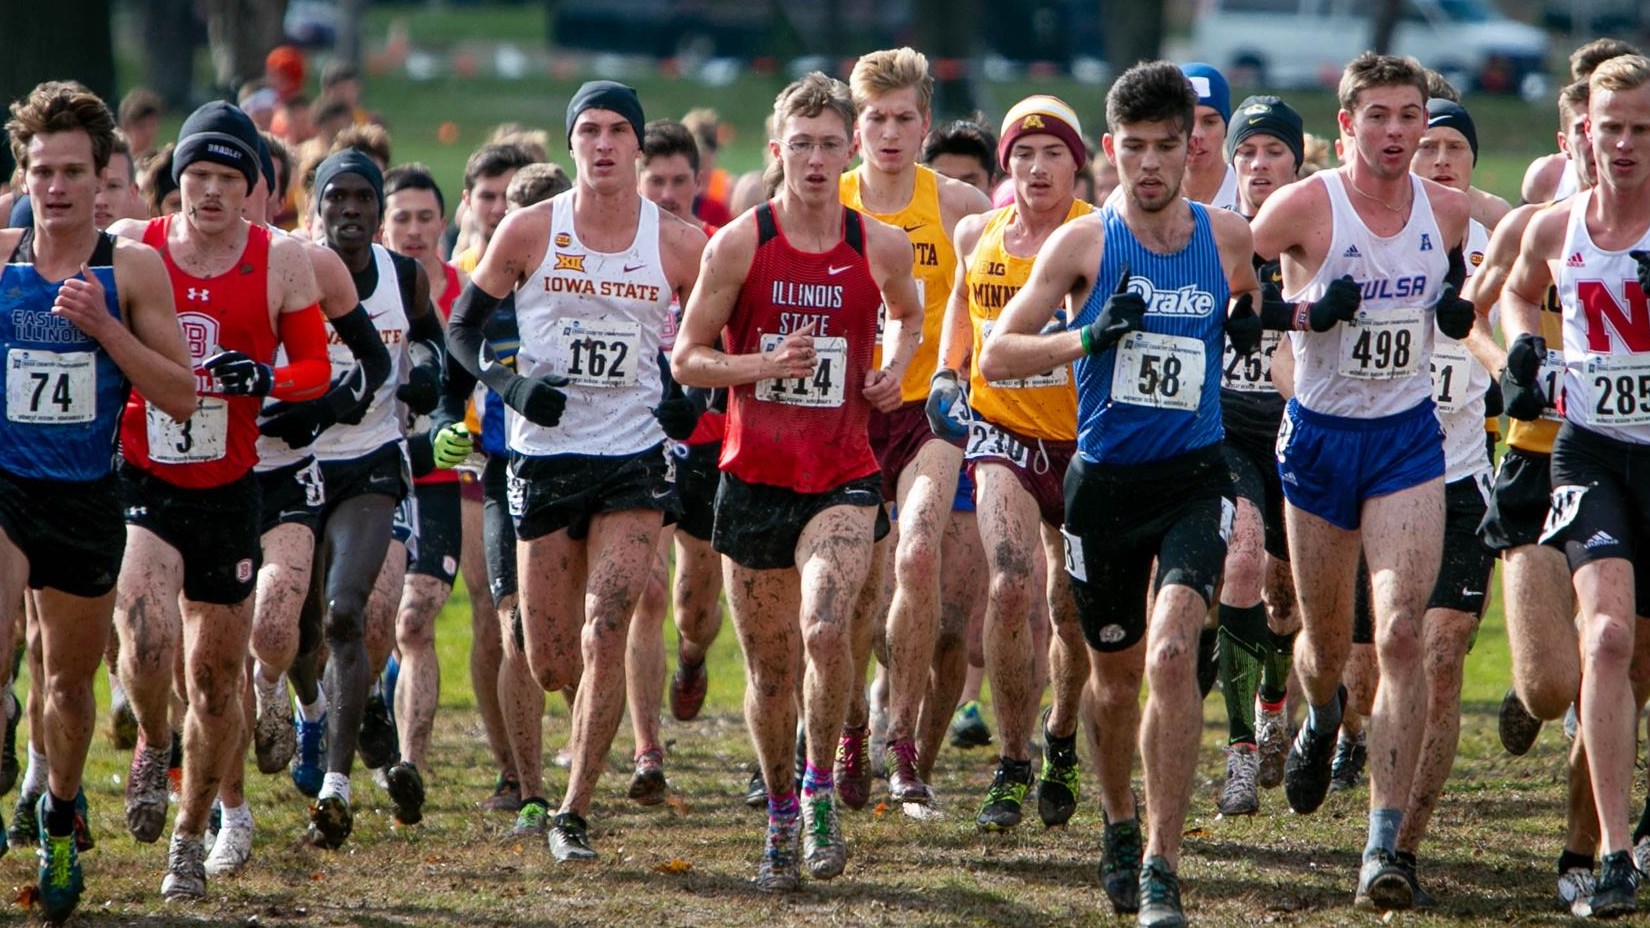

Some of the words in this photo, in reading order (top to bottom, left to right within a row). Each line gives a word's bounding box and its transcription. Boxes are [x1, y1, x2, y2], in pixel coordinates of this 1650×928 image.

[1021, 115, 1046, 129] M
[207, 143, 243, 159] BRADLEY
[911, 242, 938, 265] TA
[1420, 233, 1433, 251] A
[544, 277, 596, 295] IOWA
[601, 282, 660, 302] STATE
[772, 280, 843, 308] ILLINOIS
[973, 282, 1022, 308] MINN
[11, 309, 74, 328] EASTE
[1576, 279, 1650, 354] N
[568, 339, 628, 378] 162
[1352, 329, 1411, 369] 498
[1137, 353, 1182, 398] 58
[1430, 363, 1453, 402] 1
[30, 372, 73, 413] 74
[1595, 375, 1650, 416] 285
[176, 418, 192, 453] 3
